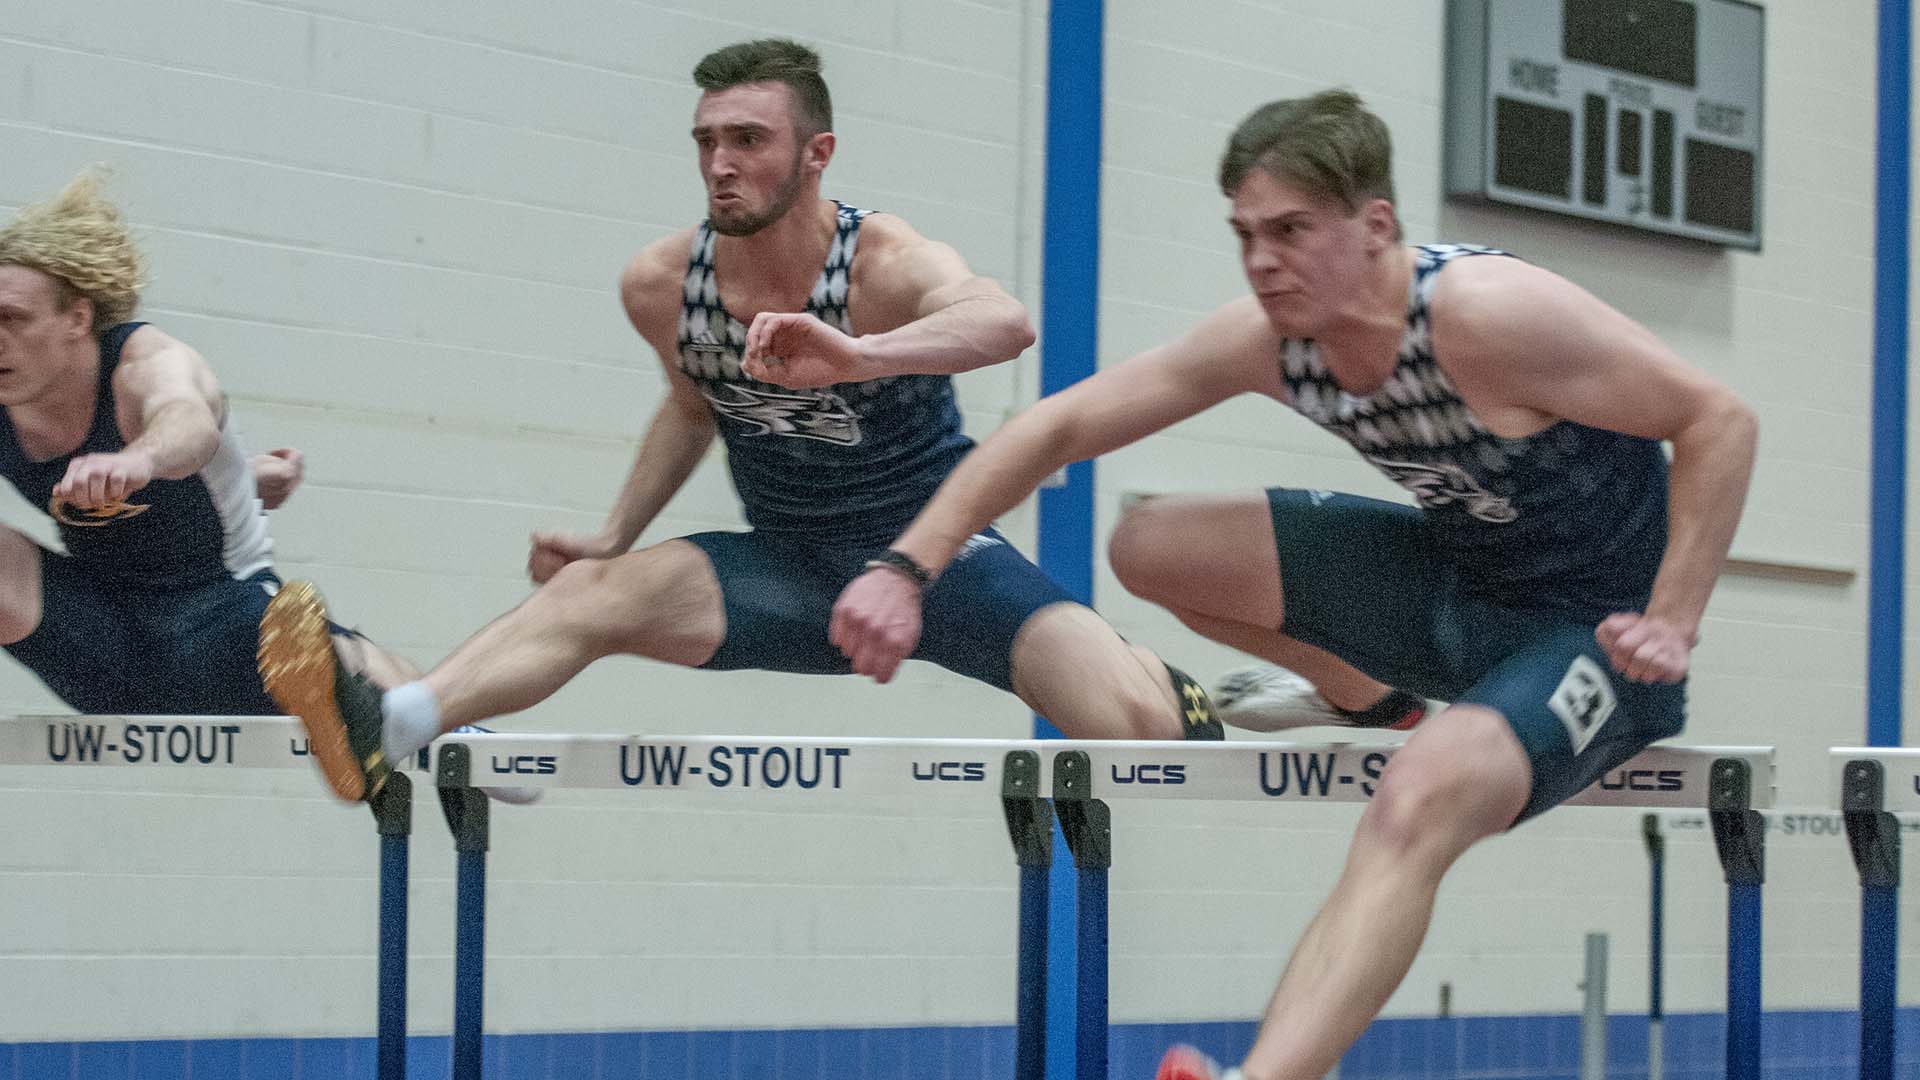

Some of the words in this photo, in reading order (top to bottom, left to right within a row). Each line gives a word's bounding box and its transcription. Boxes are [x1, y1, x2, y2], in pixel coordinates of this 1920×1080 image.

[48, 724, 241, 764] UW-STOUT
[492, 755, 557, 775] UCS
[619, 744, 850, 789] UW-STOUT
[912, 762, 986, 782] UCS
[1111, 764, 1187, 785] UCS
[1600, 770, 1685, 791] UCS
